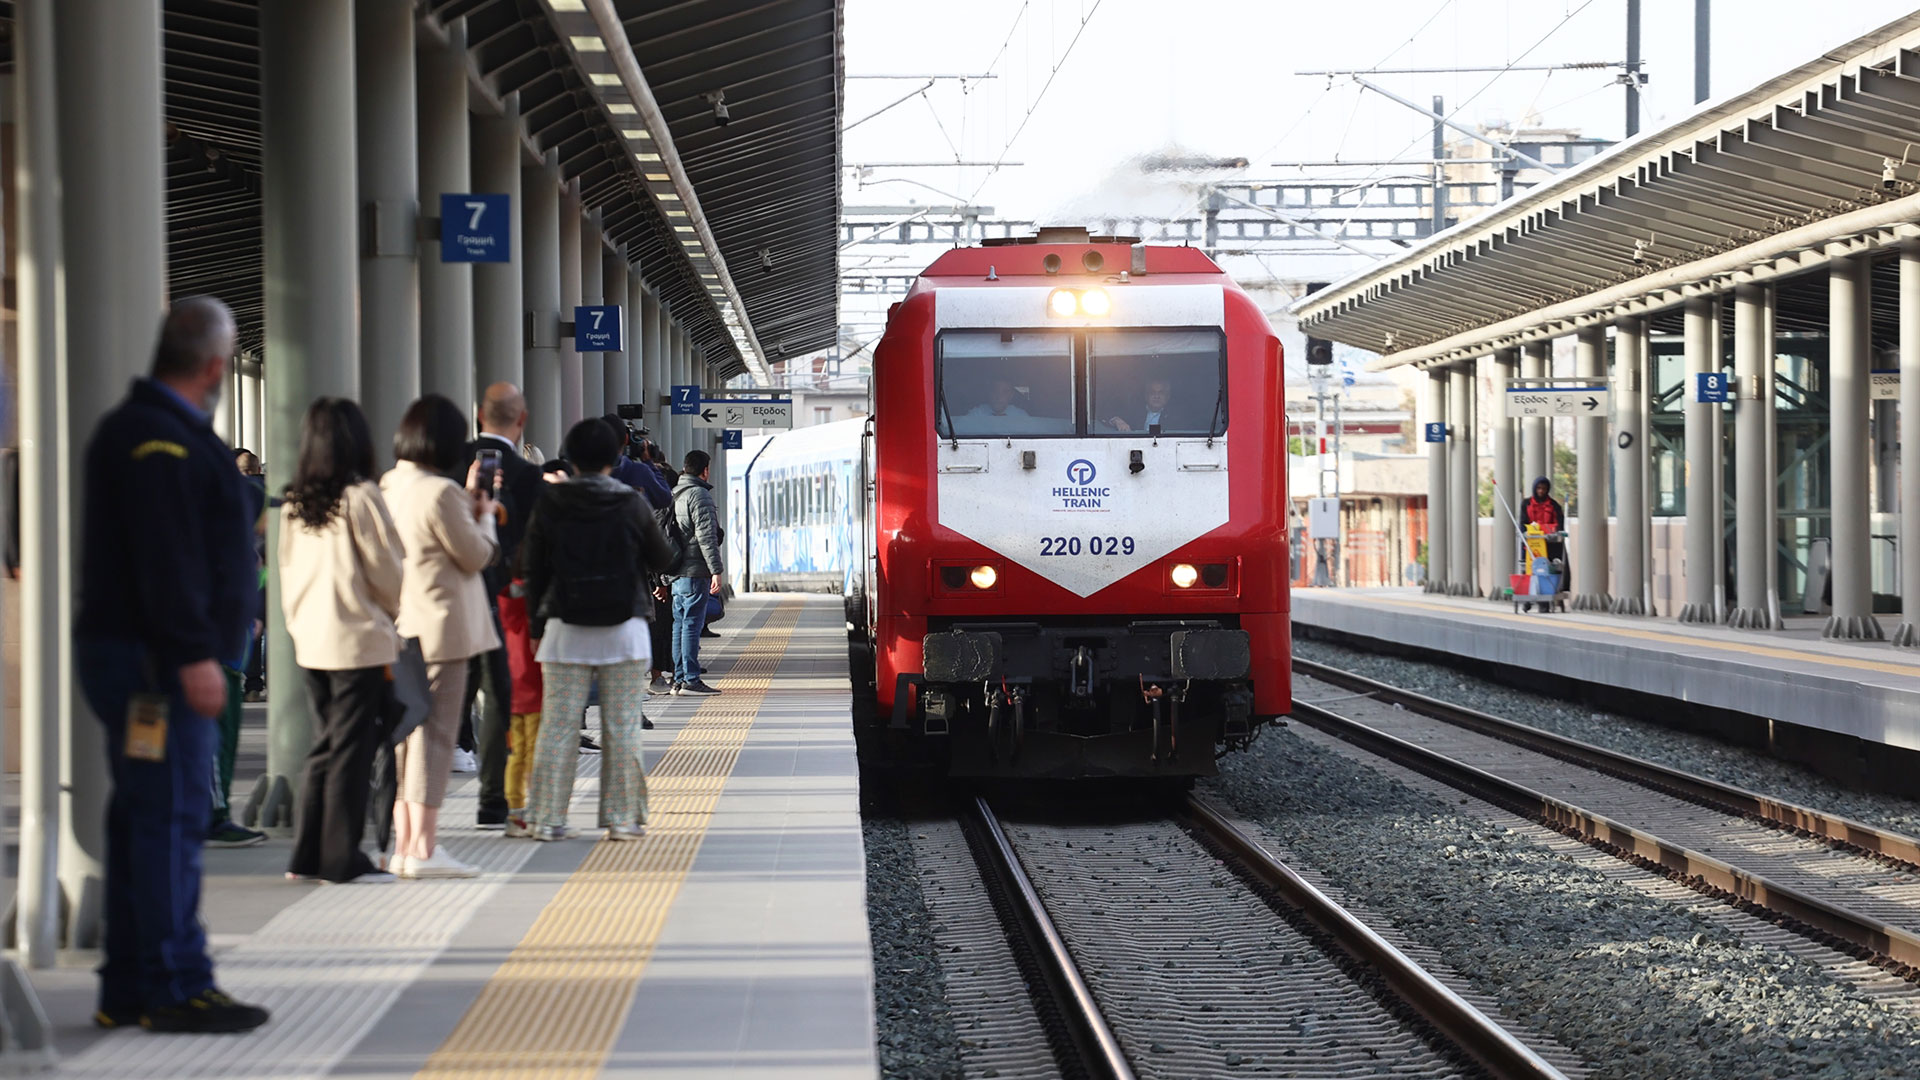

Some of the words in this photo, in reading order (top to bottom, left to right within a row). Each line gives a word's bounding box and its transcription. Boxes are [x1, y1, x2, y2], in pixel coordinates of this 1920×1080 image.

[465, 202, 487, 230] 7
[590, 311, 604, 330] 7
[1707, 376, 1718, 389] 8
[680, 389, 690, 401] 7
[752, 406, 786, 416] Έξοδος
[1432, 424, 1439, 433] 8
[729, 432, 736, 441] 7
[1052, 487, 1110, 497] HELLENIC
[1062, 498, 1101, 508] TRAIN
[1040, 537, 1081, 556] 220
[1089, 536, 1135, 555] 029
